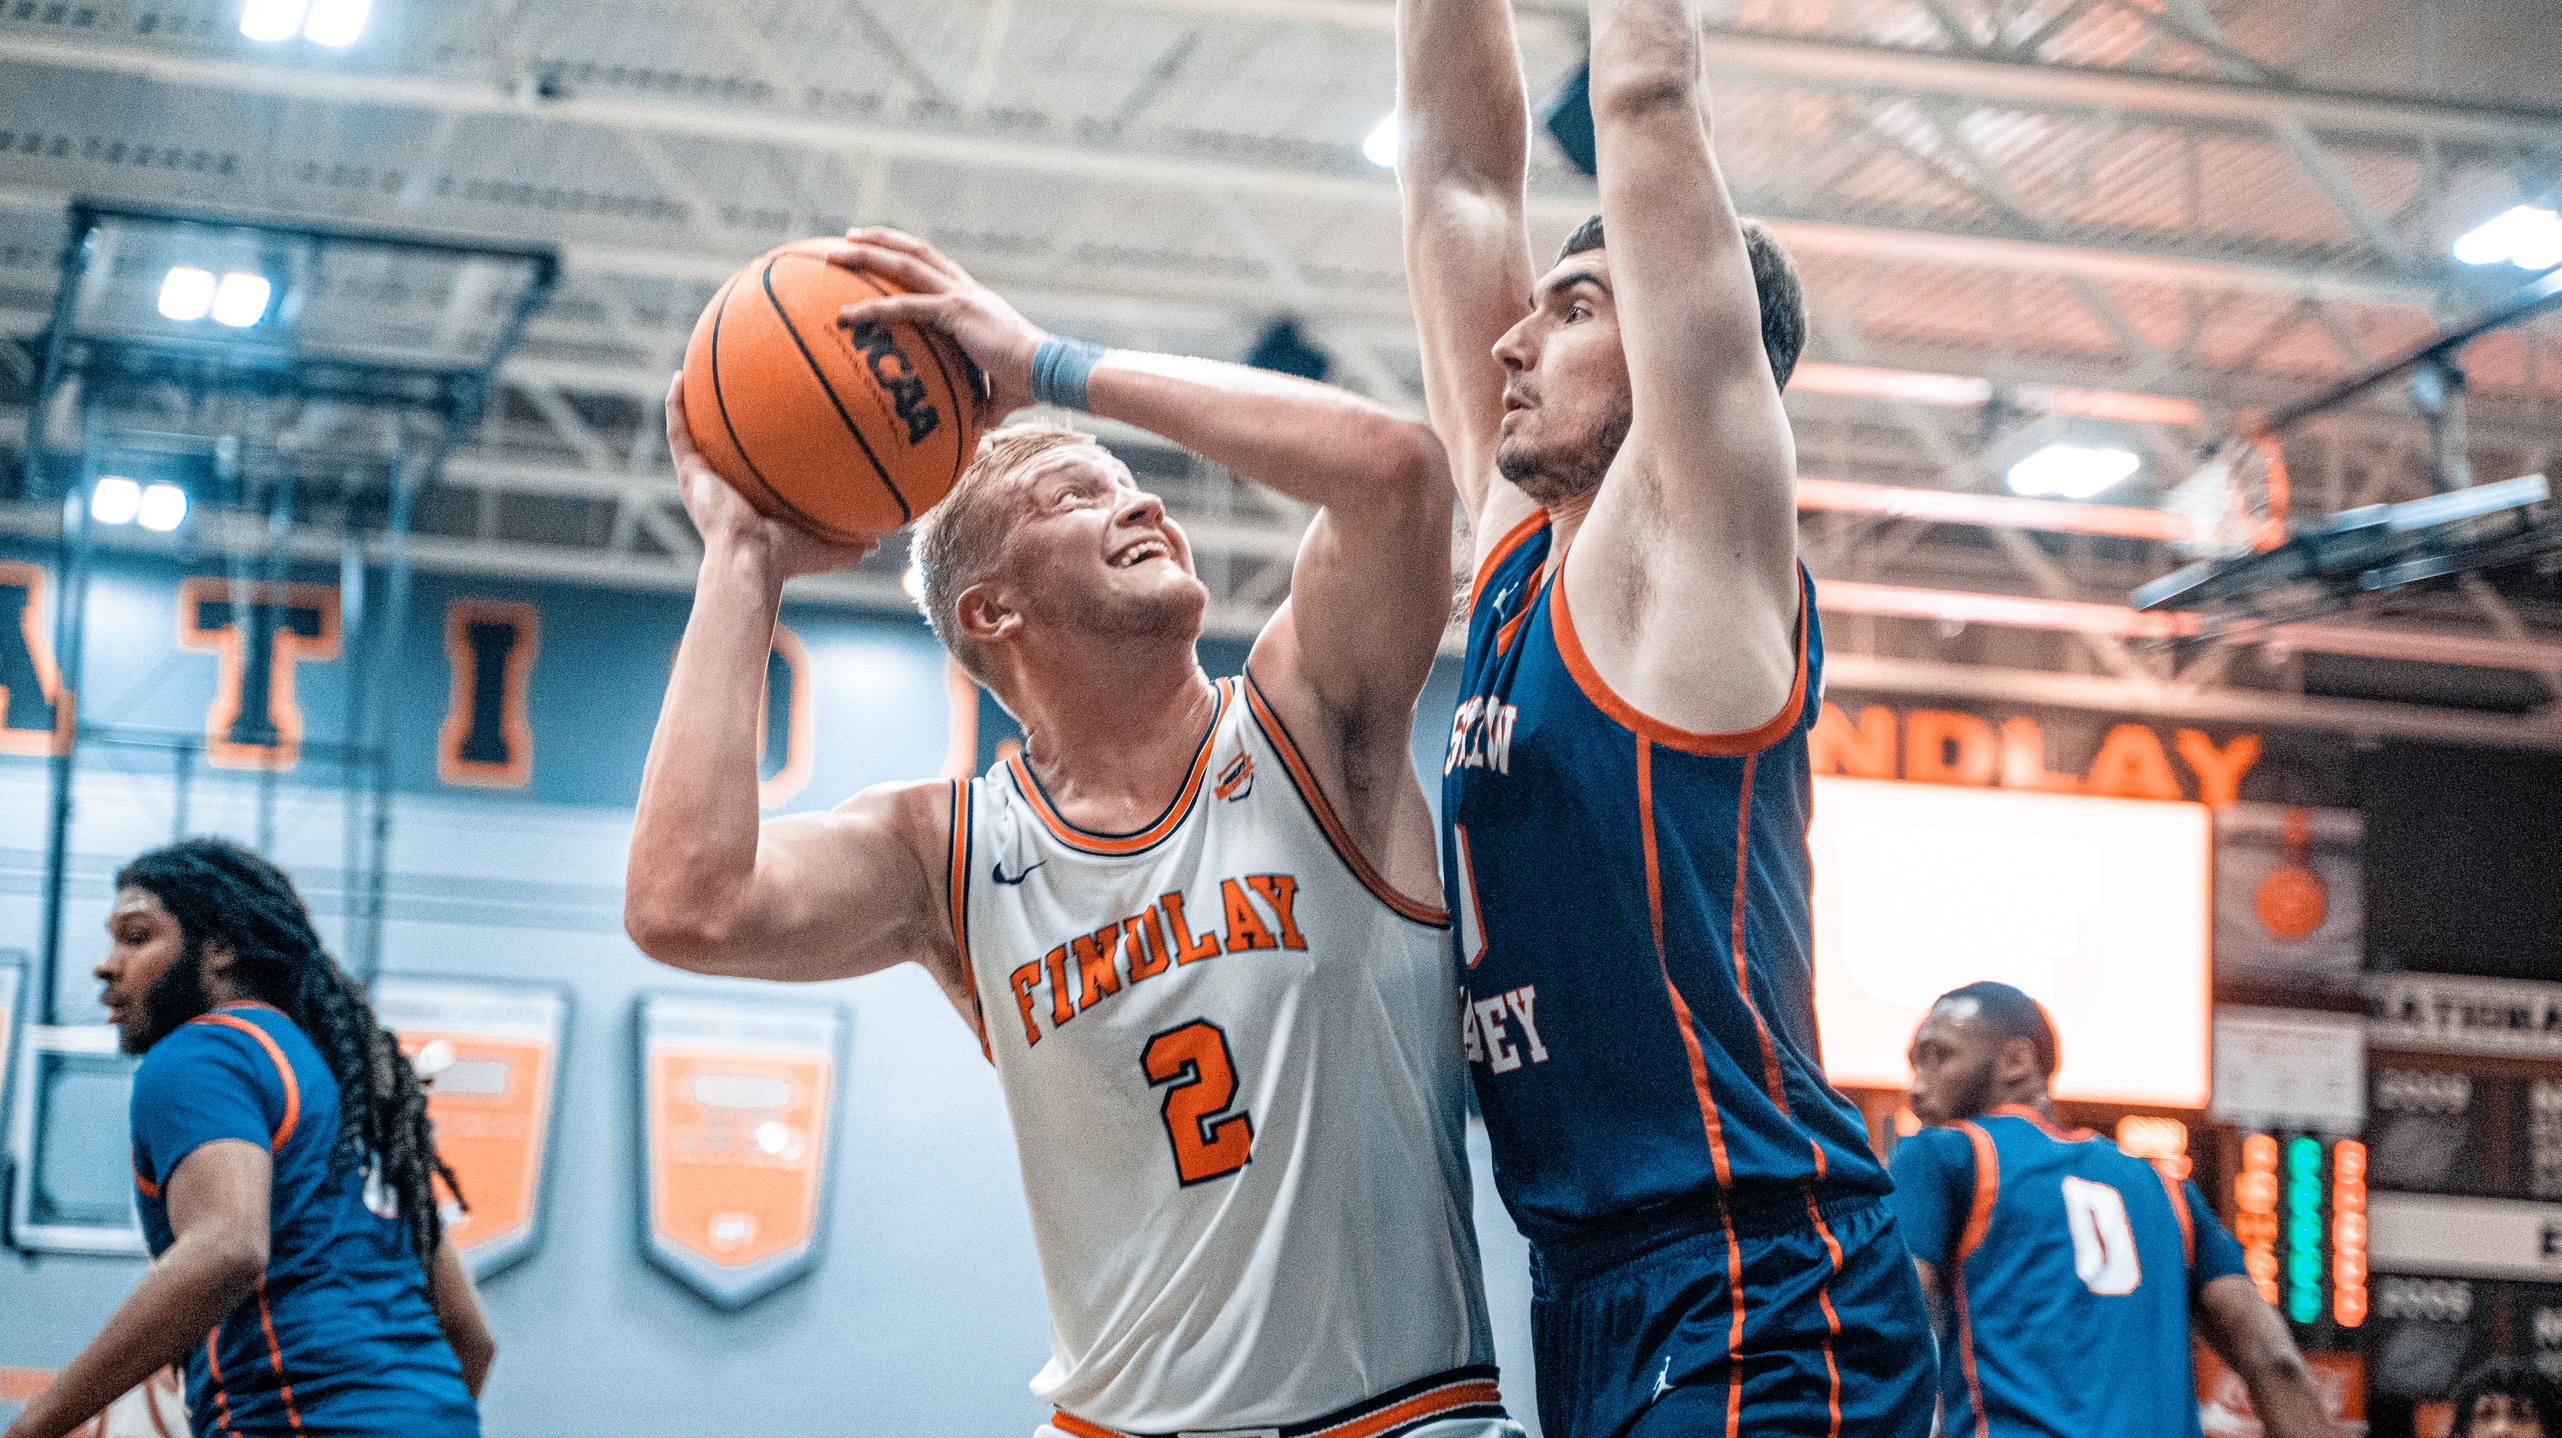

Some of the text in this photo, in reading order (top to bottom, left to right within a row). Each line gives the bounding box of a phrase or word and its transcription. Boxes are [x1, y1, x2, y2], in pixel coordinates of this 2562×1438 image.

[1009, 873, 1308, 1048] FINDLAY
[1139, 1016, 1254, 1189] 2
[2061, 1174, 2142, 1297] 0
